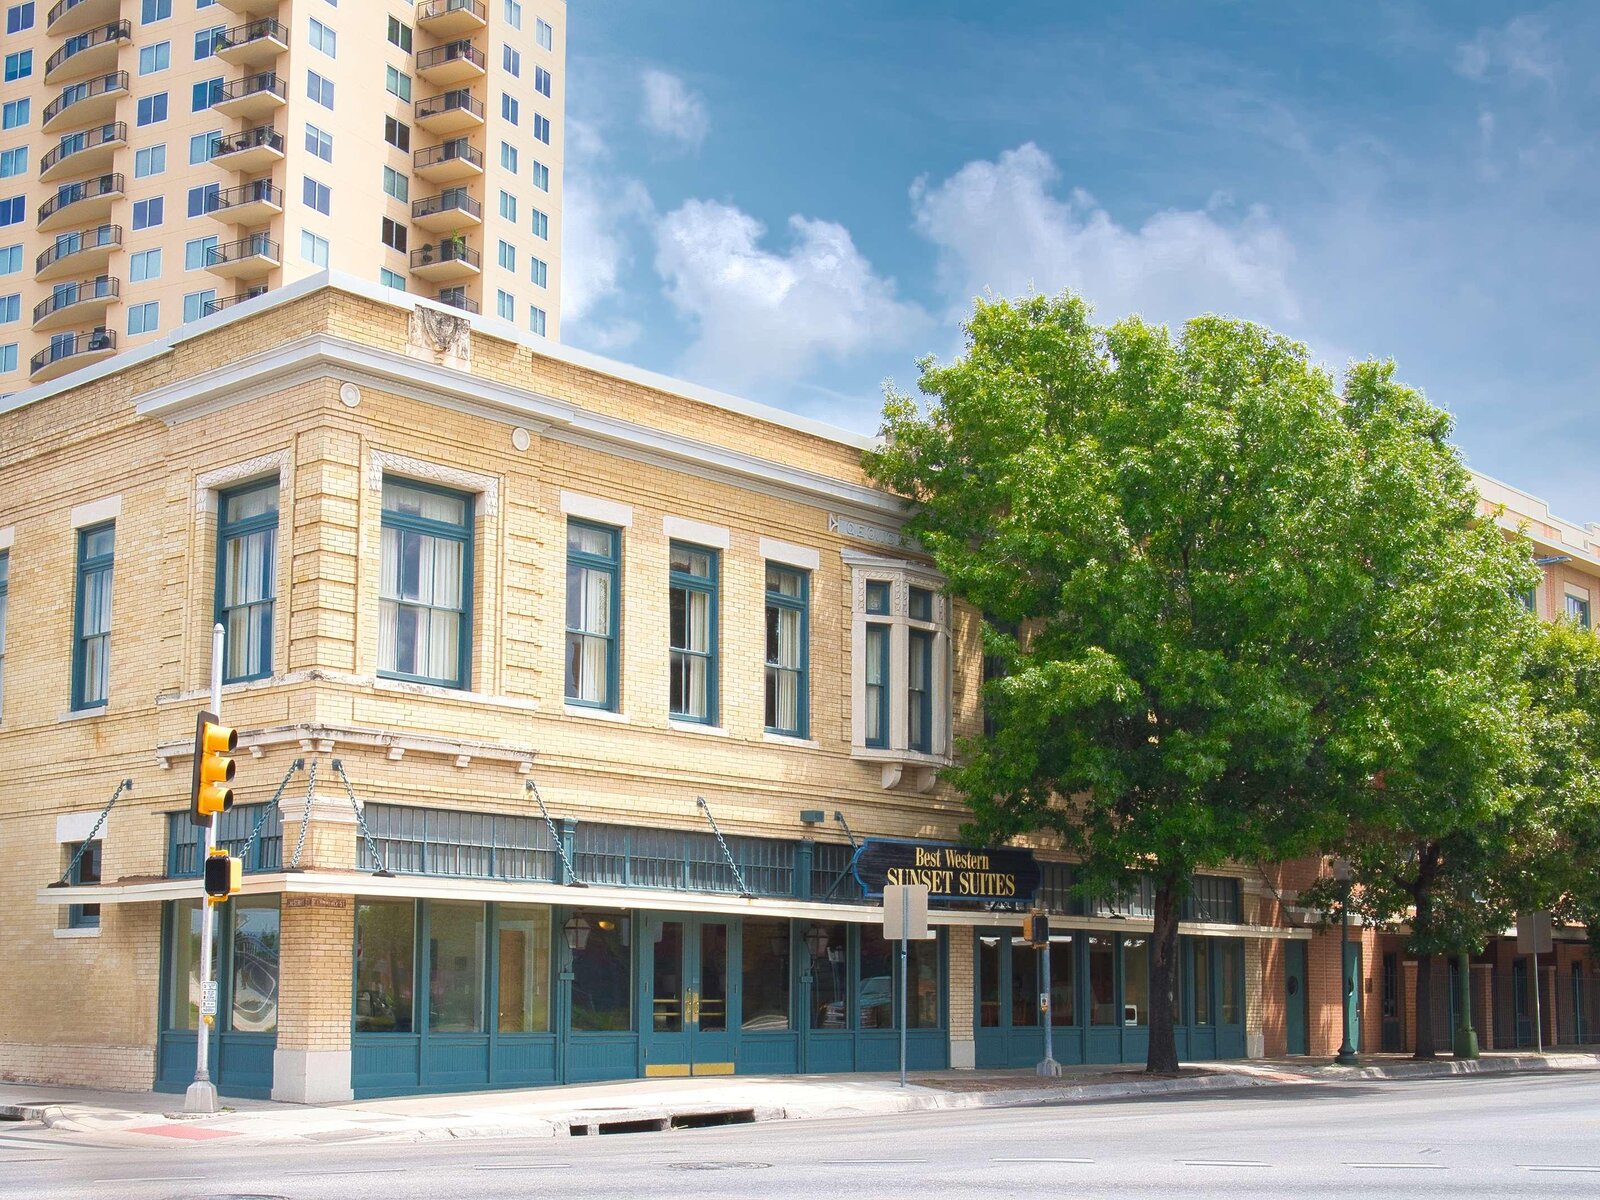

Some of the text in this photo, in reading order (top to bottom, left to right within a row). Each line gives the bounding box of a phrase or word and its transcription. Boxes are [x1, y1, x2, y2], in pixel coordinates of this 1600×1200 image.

[915, 847, 989, 870] Best Western
[887, 867, 1015, 896] SUNSET SUITES
